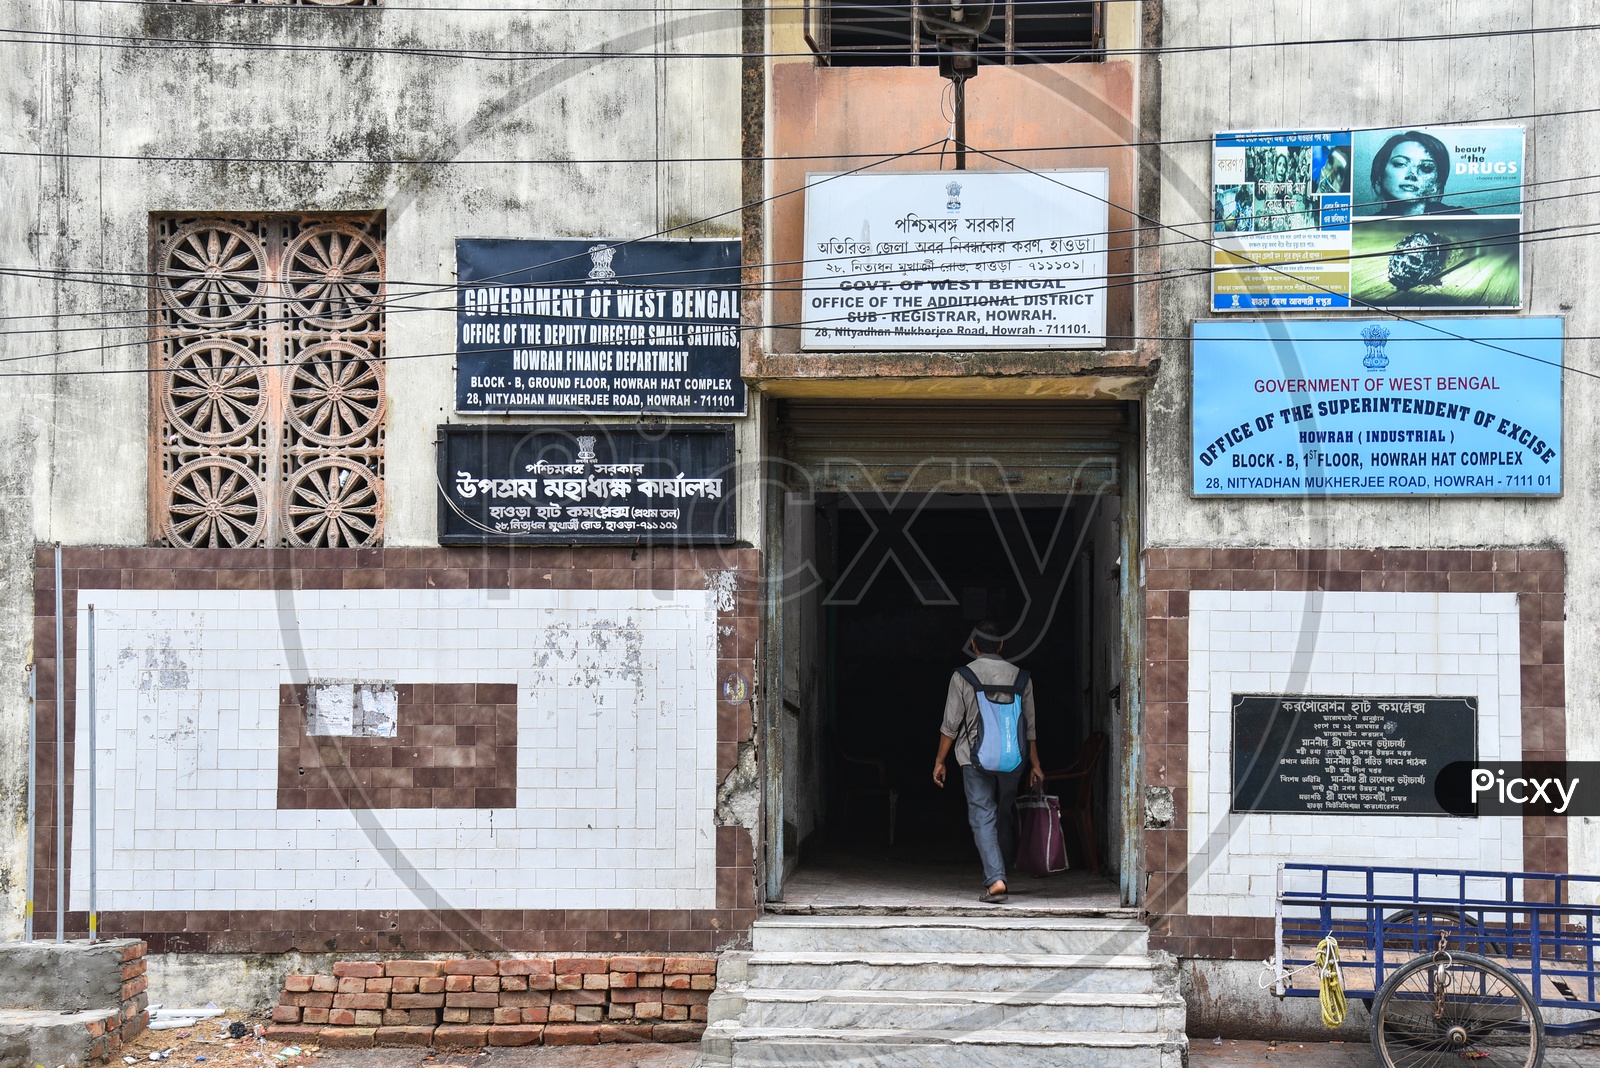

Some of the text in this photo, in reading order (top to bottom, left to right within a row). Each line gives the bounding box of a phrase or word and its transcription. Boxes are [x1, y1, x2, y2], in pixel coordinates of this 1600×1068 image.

[1455, 145, 1487, 154] beauty
[1467, 154, 1485, 162] the
[1455, 161, 1518, 174] DRUGS
[895, 213, 1015, 233] পশ্চিমবঙ্গ সরকার
[817, 237, 871, 254] অতিরিক্ত
[876, 241, 908, 254] জেলা
[915, 242, 944, 254] অবর
[1012, 239, 1043, 254] করণ,
[851, 260, 893, 274] নিত্যধন
[975, 261, 1011, 273] হাওড়া
[840, 279, 1066, 291] GOVT. OF WEST BENGAL
[464, 287, 740, 318] GOVERNMENT OF WEST BENGAL
[812, 294, 1094, 308] OFFICE OF THE ADDITIONAL DISTRICT
[847, 312, 878, 322] SUB
[891, 311, 981, 324] REGISTRAR,
[986, 309, 1057, 321] HOWRAH.
[463, 323, 740, 348] OFFICE OF THE DEPUTY DIRECTOR SMALL SAVINGS,
[815, 328, 831, 339] 28,
[835, 327, 891, 339] Nityadhan
[895, 326, 953, 338] Mukherjee
[957, 325, 988, 336] Road,
[993, 325, 1035, 335] Howrah
[1046, 324, 1091, 334] 711101.
[513, 350, 689, 372] HOWRAH FINANCE DEPARTMENT
[471, 376, 505, 388] BLOCK
[515, 376, 525, 390] B,
[528, 377, 571, 389] GROUND
[574, 377, 611, 391] FLOOR,
[614, 378, 657, 389] HOWRAH
[661, 378, 681, 390] HAT
[685, 378, 732, 390] COMPLEX
[1254, 376, 1500, 393] GOVERNMENT OF WEST BENGAL
[467, 392, 482, 406] 28,
[485, 393, 544, 405] NITYADHAN
[548, 394, 609, 405] MUKHERJEE
[613, 394, 644, 407] ROAD,
[647, 394, 690, 406] HOWRAH
[701, 395, 735, 407] 711101
[1199, 397, 1556, 467] OFFICE OF THE SUPERINTENDENT OF EXCISE
[1299, 431, 1353, 443] HOWRAH
[1366, 430, 1446, 443] INDUSTRIAL
[525, 460, 644, 476] পশ্চিমবঙ্গ সরকার
[1232, 453, 1275, 468] BLOCK
[1286, 453, 1299, 470] B,
[1318, 453, 1363, 469] FLOOR,
[1371, 452, 1427, 466] HOWRAH
[1431, 452, 1456, 466] HAT
[1461, 451, 1523, 465] COMPLEX
[456, 470, 722, 502] উপশ্রম মহাধ্যক্ষ কার্যালয়
[1206, 477, 1223, 490] 28,
[1227, 477, 1300, 489] NITYADHAN
[1305, 476, 1385, 488] MUKHERJEE
[1389, 476, 1430, 489] ROAD,
[1434, 475, 1494, 487] HOWRAH
[489, 502, 680, 520] হাওড়া হাট কমপ্লেক্স (প্রথম তল)
[548, 518, 579, 532] মুখার্জী
[1282, 700, 1425, 714] করপোরেশন হাট কমপ্লেক্স
[1302, 737, 1328, 747] মাননীয়
[1332, 737, 1341, 747] শ্রী
[1325, 755, 1351, 765] মাননীয়
[1352, 755, 1362, 765] শ্রী
[1331, 773, 1356, 783] মাননীয়
[1358, 773, 1367, 783] শ্রী
